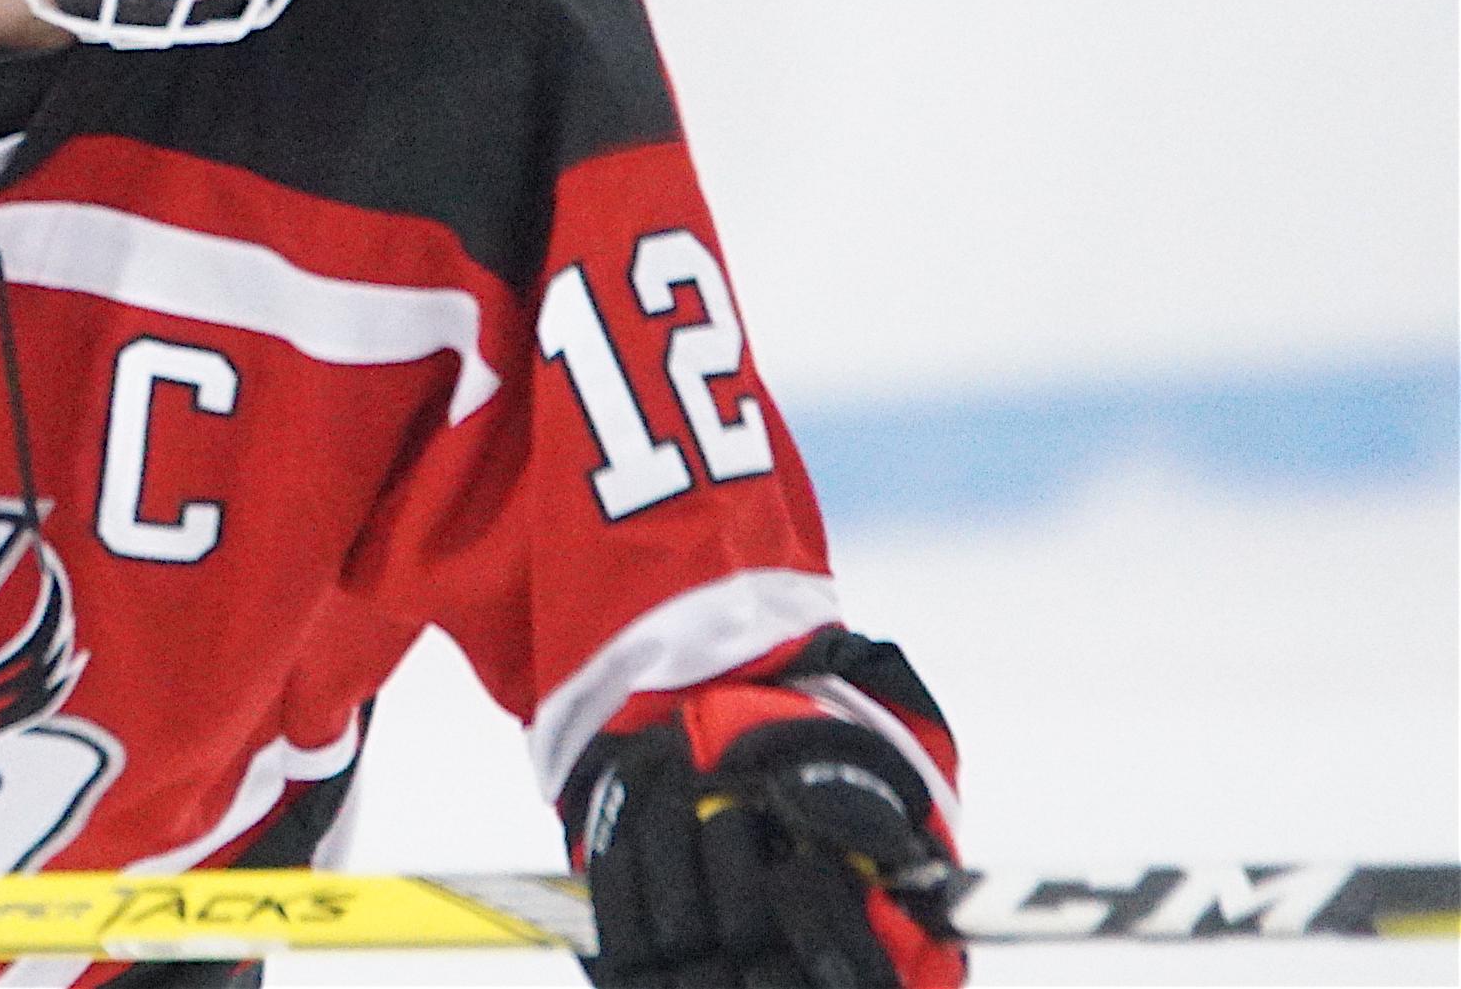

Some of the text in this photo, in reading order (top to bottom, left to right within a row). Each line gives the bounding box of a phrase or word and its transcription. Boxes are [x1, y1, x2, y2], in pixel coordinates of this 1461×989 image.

[95, 335, 240, 565] C
[535, 227, 774, 524] 12
[95, 885, 359, 937] TACKS
